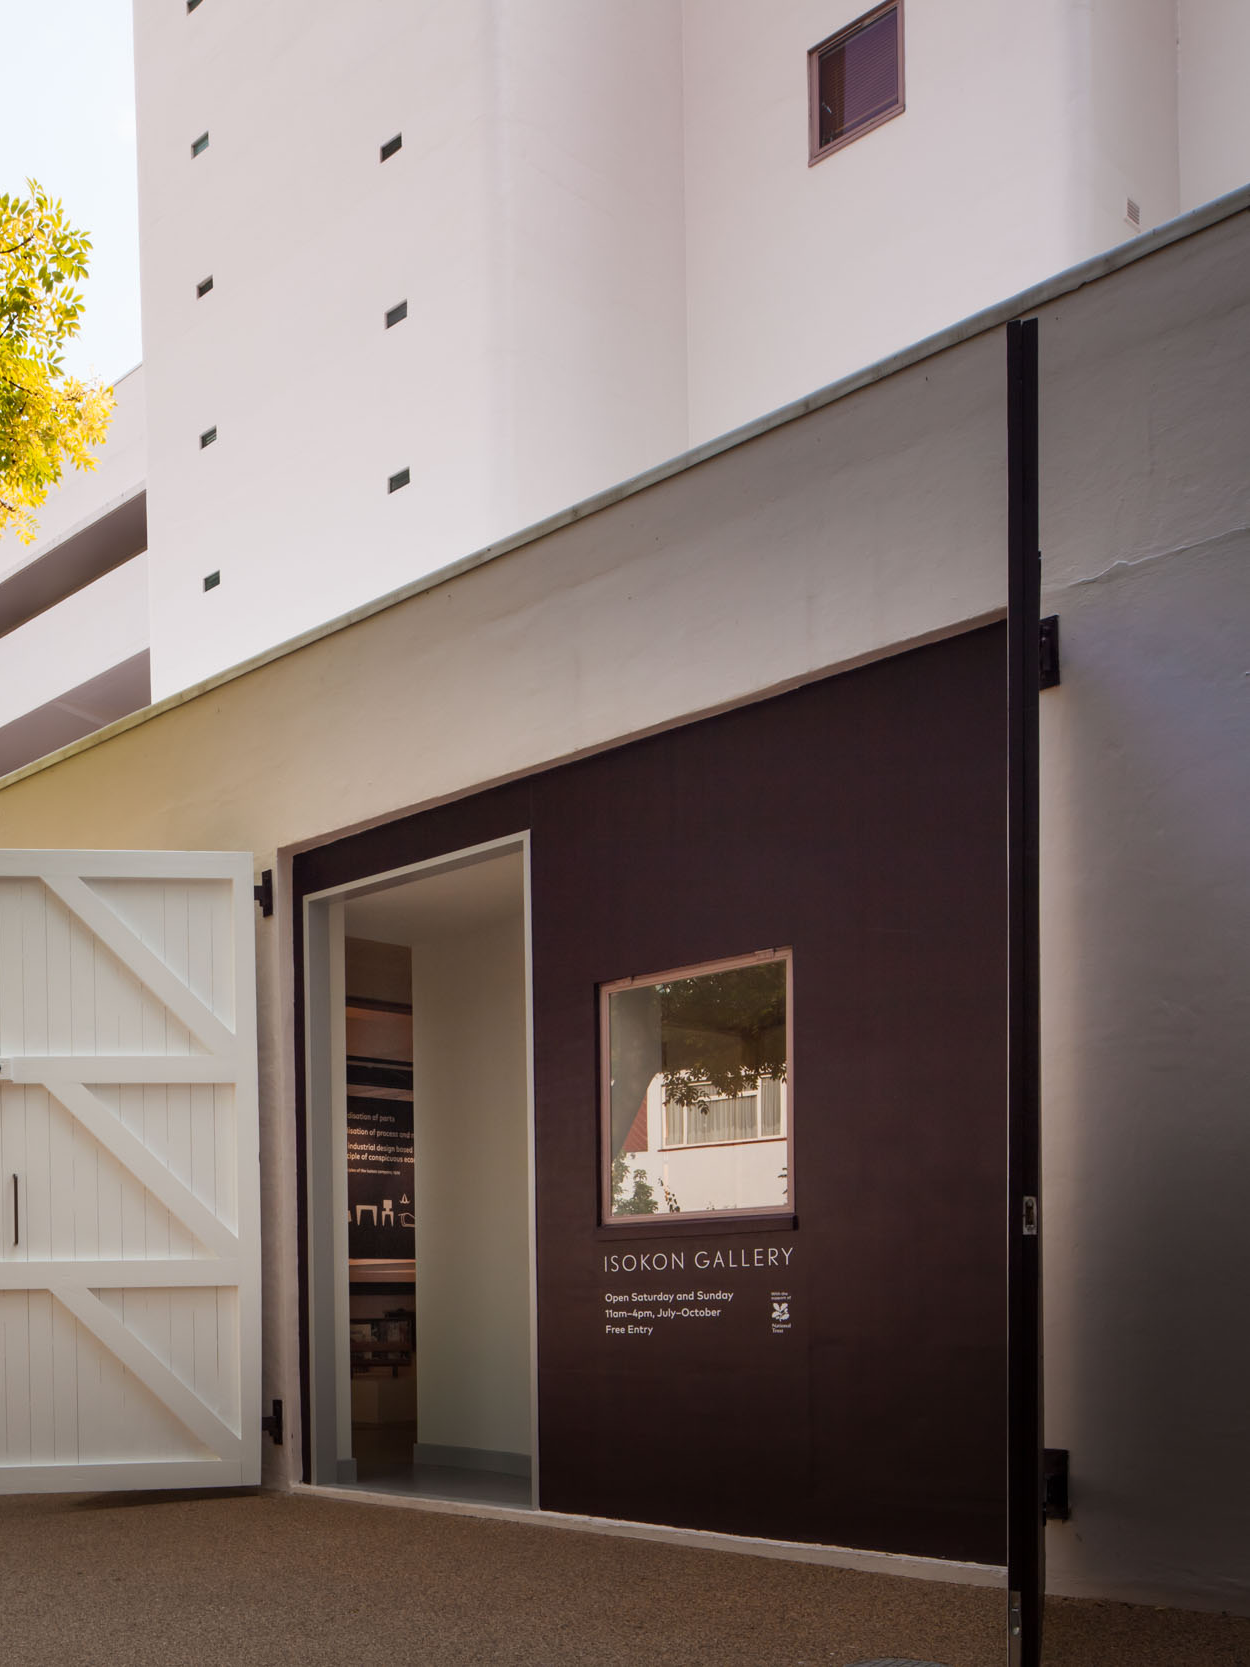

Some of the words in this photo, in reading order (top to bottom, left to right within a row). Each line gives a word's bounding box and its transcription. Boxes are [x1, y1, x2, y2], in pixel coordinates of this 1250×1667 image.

[369, 1128, 376, 1136] of
[376, 1144, 395, 1153] design
[361, 1152, 368, 1160] of
[604, 1252, 685, 1273] ISOKON
[694, 1247, 793, 1269] GALLERY
[605, 1293, 629, 1304] Open
[631, 1292, 674, 1303] Saturday
[676, 1291, 695, 1301] and
[697, 1290, 734, 1302] Sunday
[605, 1325, 626, 1334] Free
[627, 1325, 654, 1336] Entry
